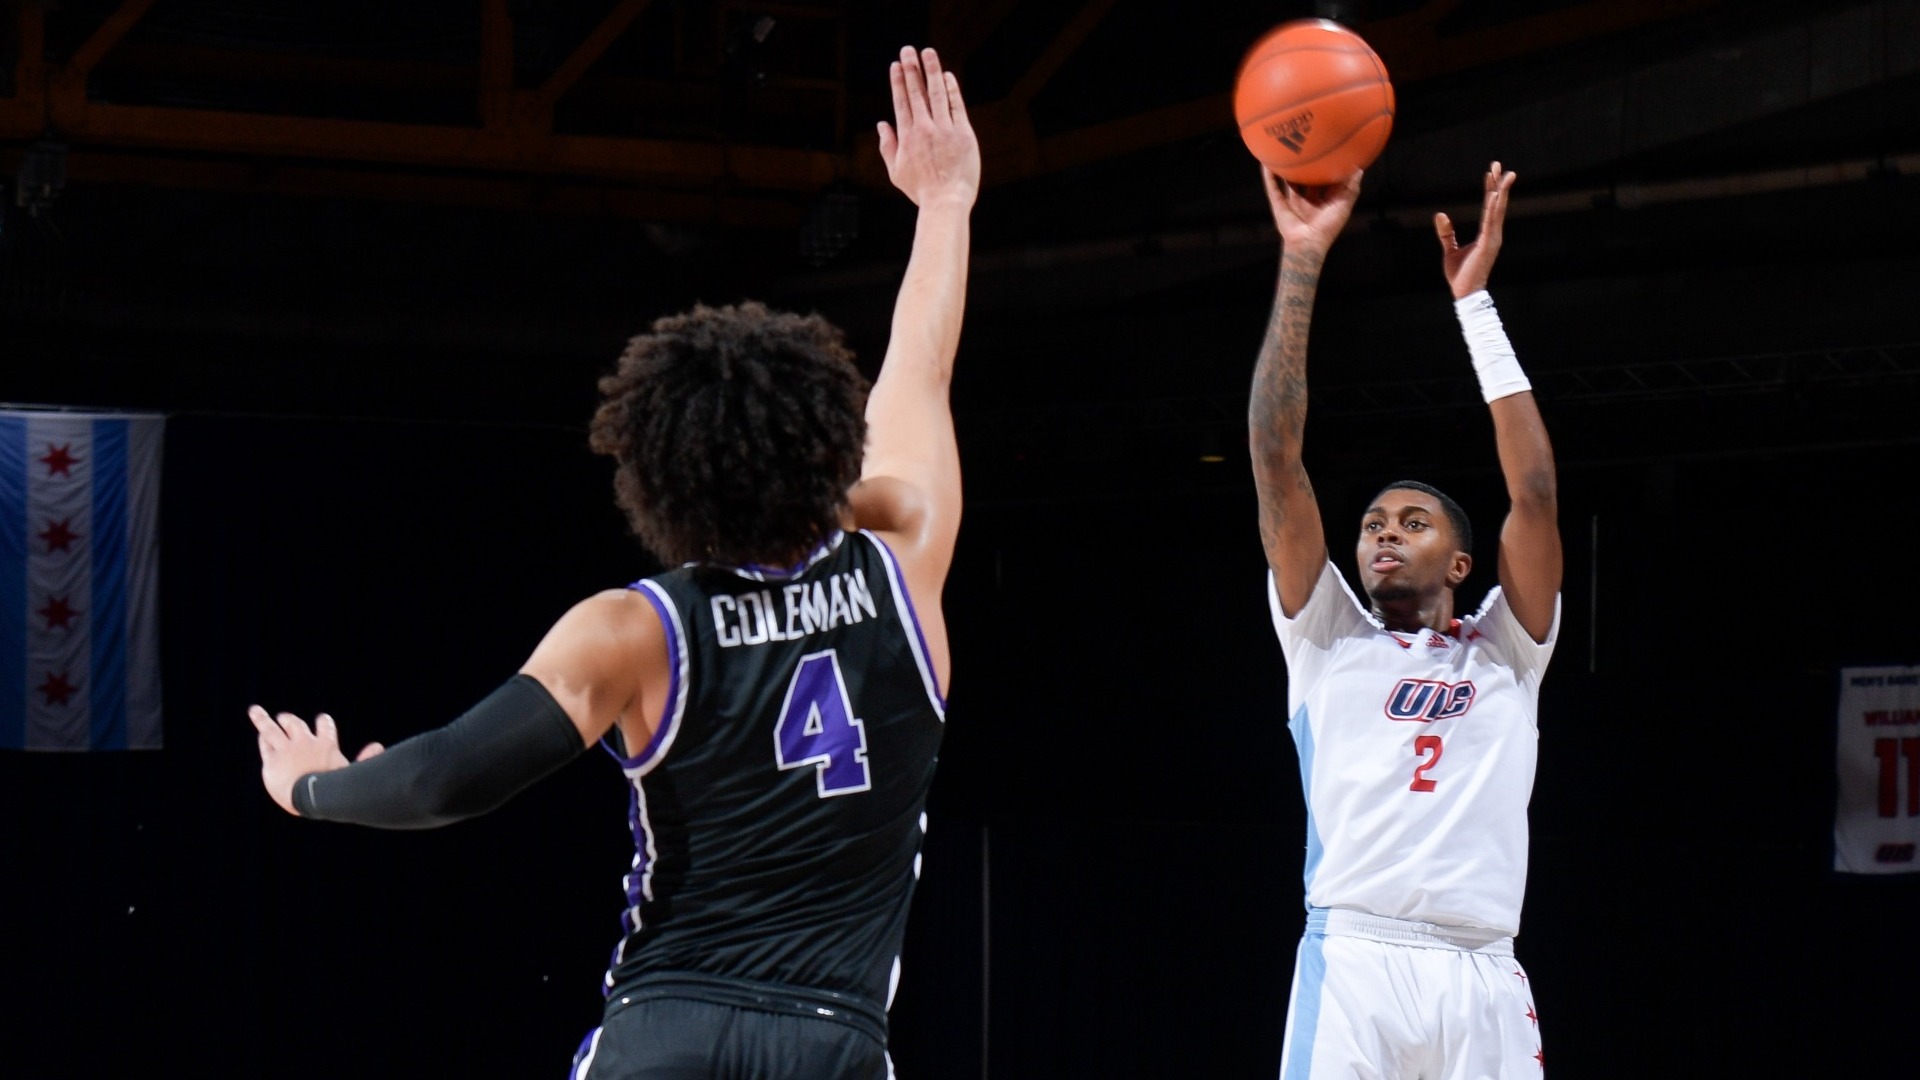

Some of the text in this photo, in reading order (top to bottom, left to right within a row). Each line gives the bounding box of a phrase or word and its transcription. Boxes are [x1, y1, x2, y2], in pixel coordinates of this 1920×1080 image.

[710, 568, 878, 648] COLEMAN
[1384, 678, 1477, 723] UIC
[1887, 674, 1920, 686] BASKE
[773, 648, 872, 799] 4
[1409, 735, 1444, 793] 2
[1874, 737, 1920, 818] 11
